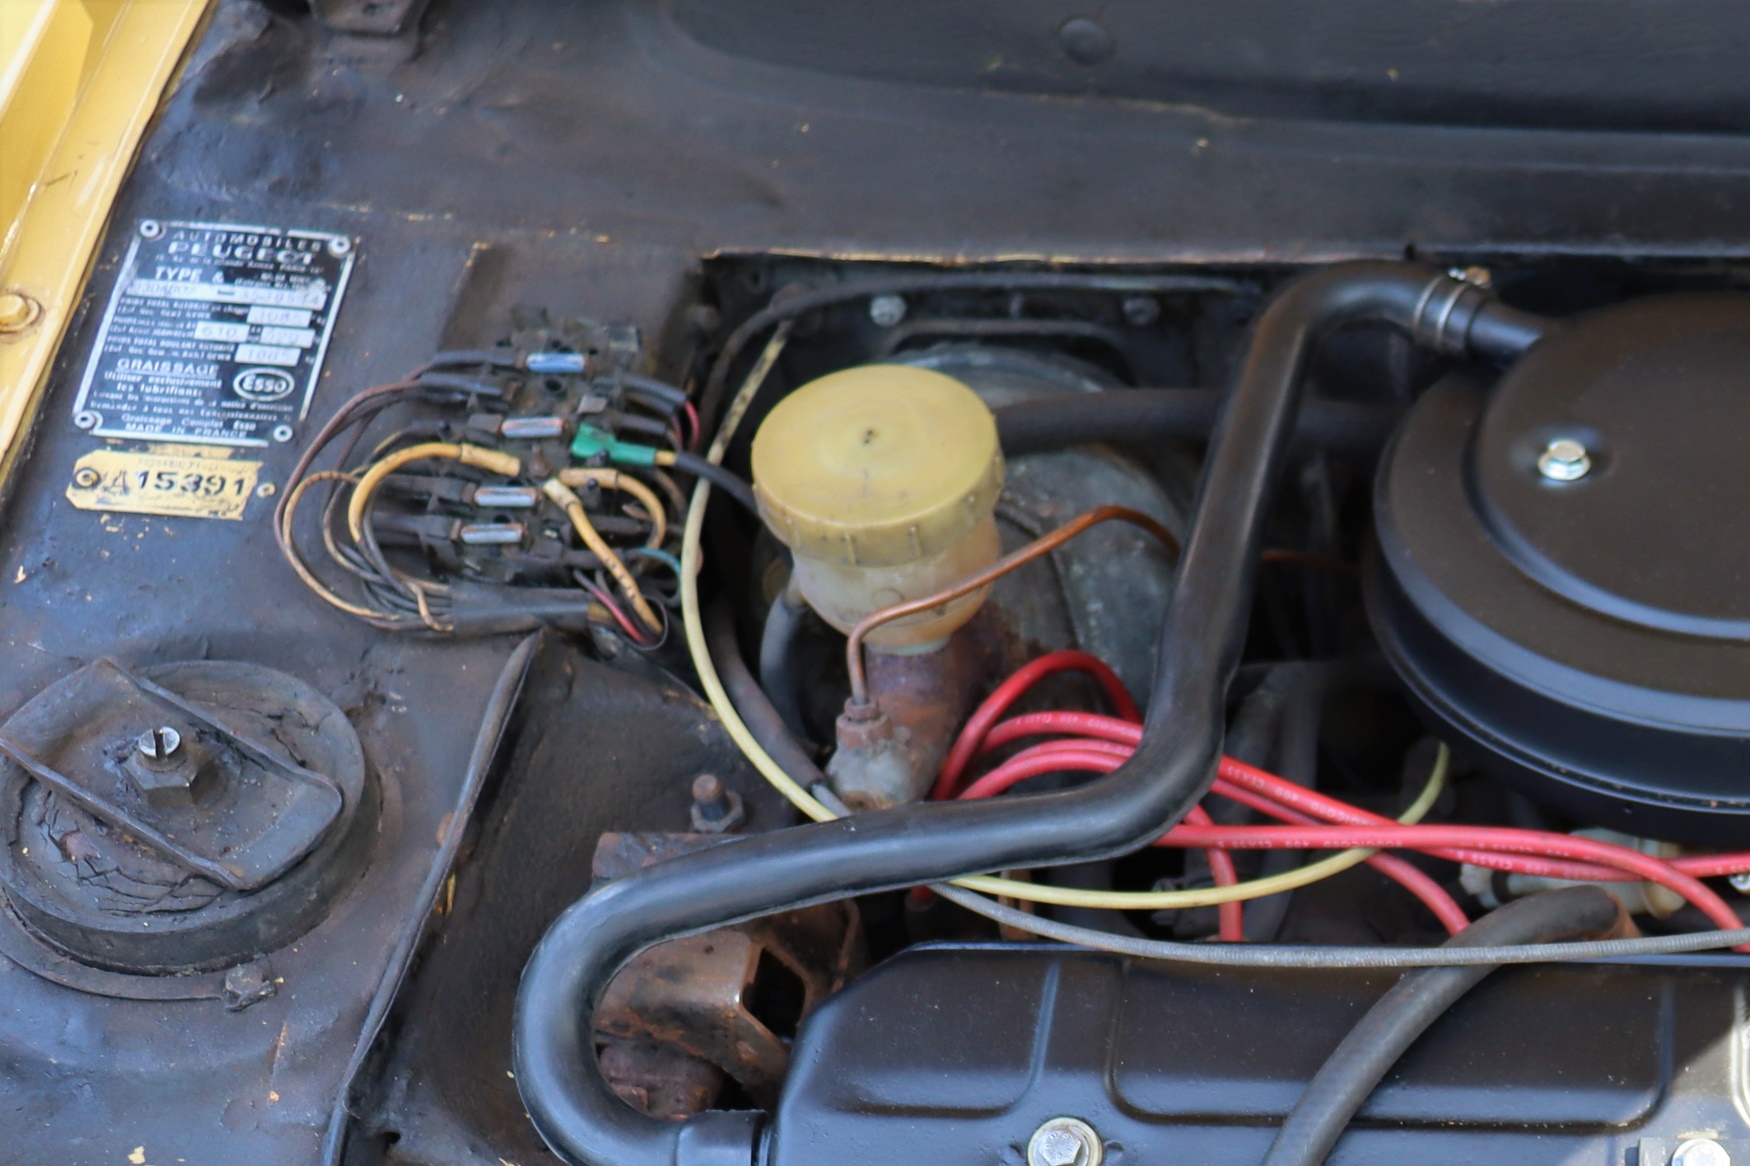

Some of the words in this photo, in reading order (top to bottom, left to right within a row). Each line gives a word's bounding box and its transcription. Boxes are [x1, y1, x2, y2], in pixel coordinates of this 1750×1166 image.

[173, 230, 322, 251] AUTOMOBILES
[168, 241, 315, 265] PEUGEOT
[155, 266, 203, 283] TYPE
[117, 358, 219, 375] GRAISSAGE
[104, 371, 143, 383] Utiliser
[148, 375, 223, 389] exclusivement
[125, 423, 162, 433] MADE
[172, 426, 186, 435] IN
[195, 428, 248, 439] FRANCE
